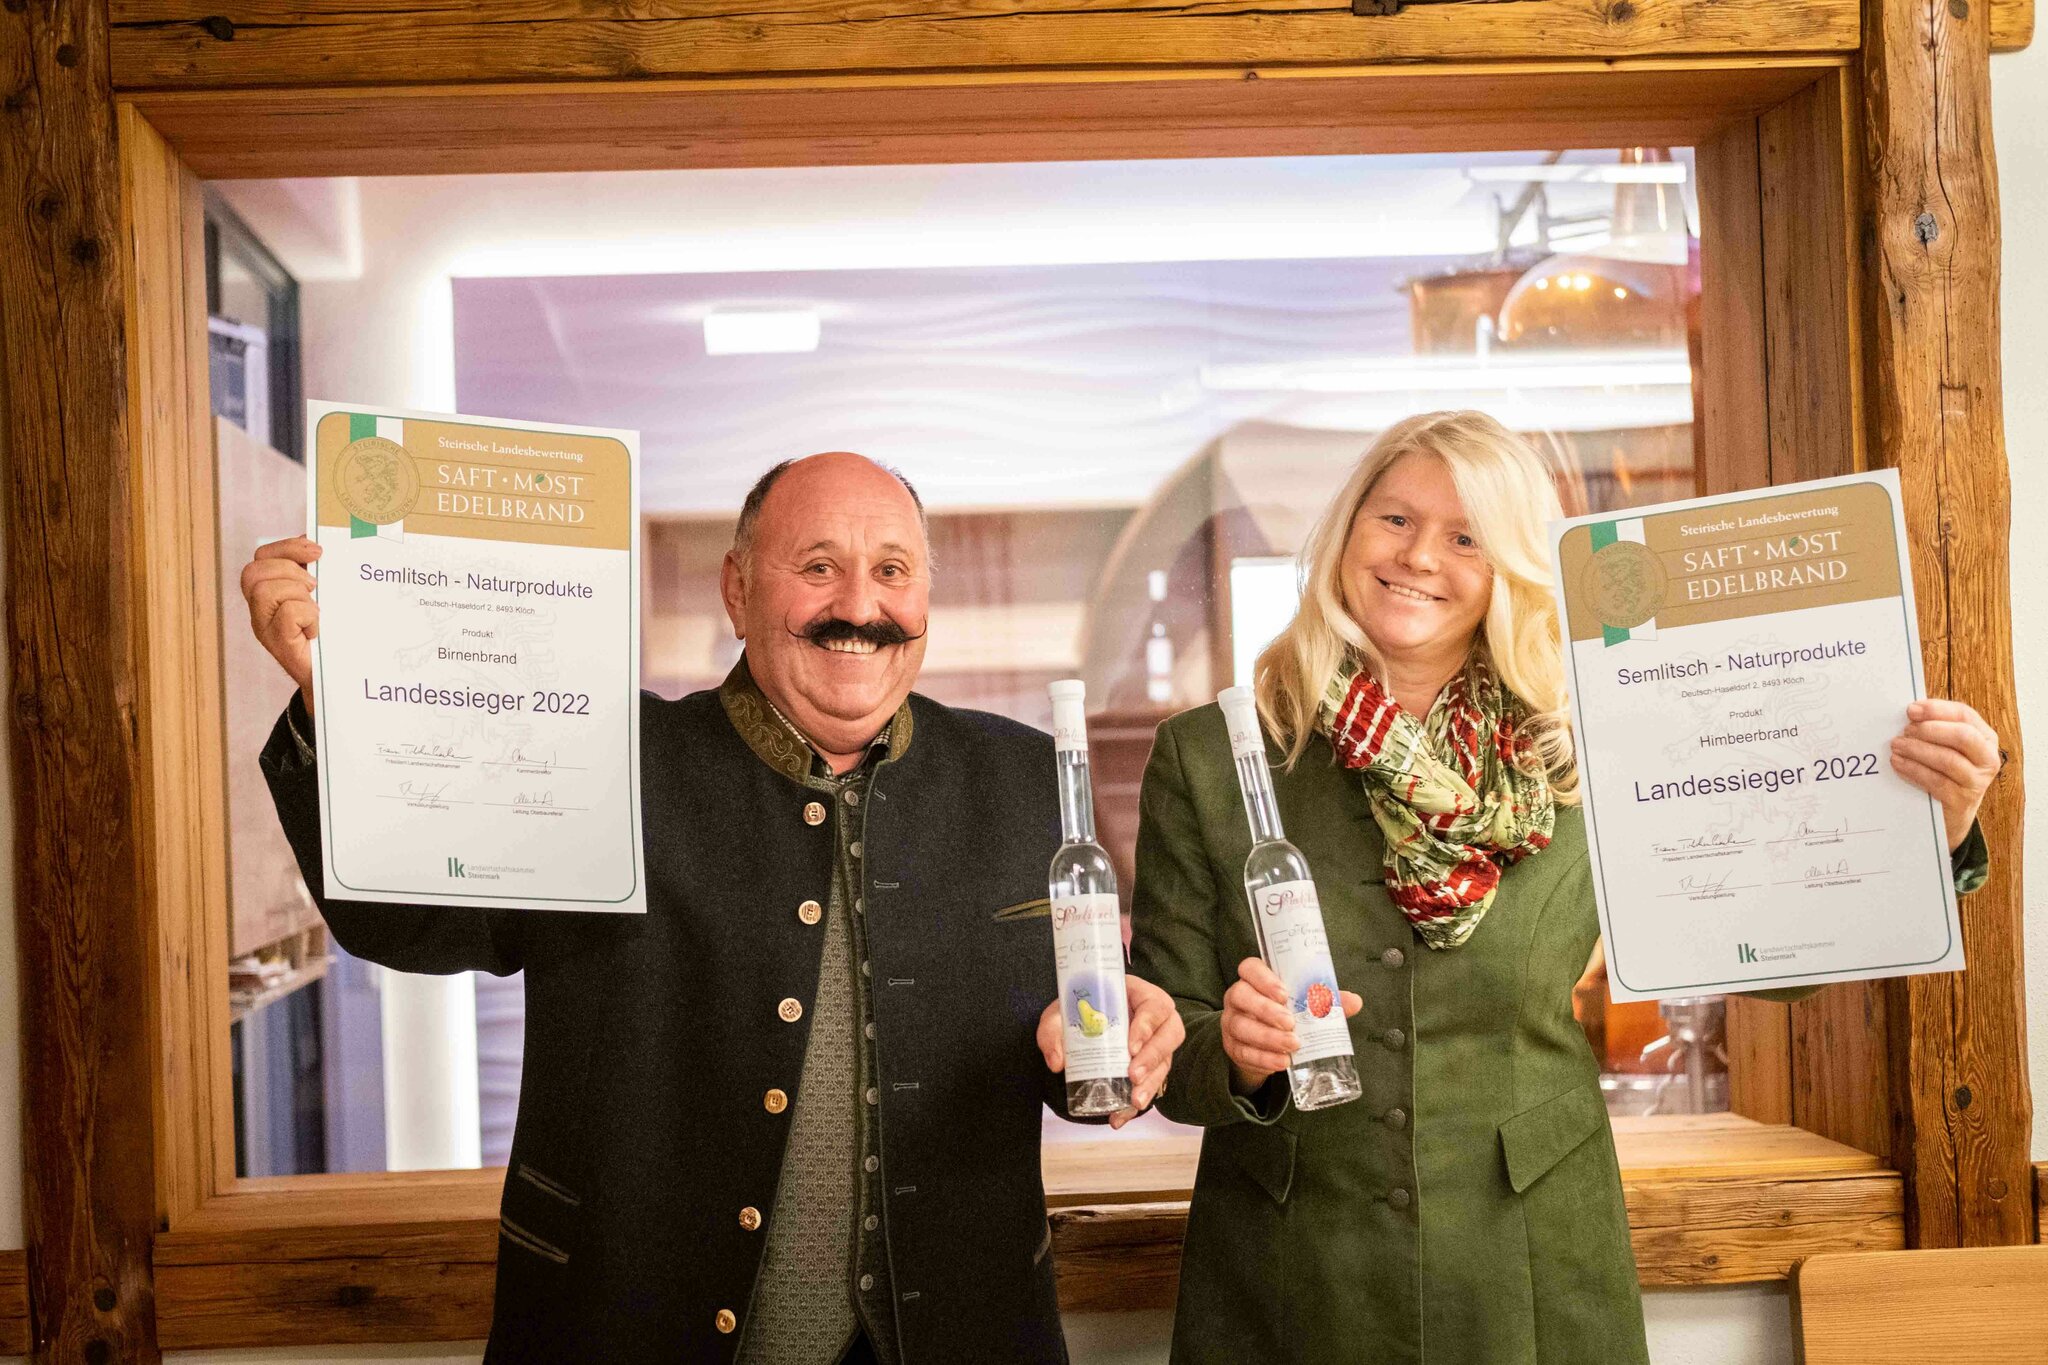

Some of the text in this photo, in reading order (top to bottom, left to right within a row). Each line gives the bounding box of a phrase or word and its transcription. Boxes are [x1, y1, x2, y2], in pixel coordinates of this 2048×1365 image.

[438, 437, 584, 462] Steirische Landesbewertung
[438, 464, 497, 486] SAFT
[438, 492, 585, 523] EDELBRAND
[1681, 504, 1839, 537] Steirische Landesbewertung
[1684, 545, 1747, 573] SAFT
[360, 563, 448, 588] Semlitsch
[467, 573, 593, 599] Naturprodukte
[1687, 560, 1848, 601] EDELBRAND
[496, 604, 514, 613] 8493
[462, 628, 494, 639] Produkt
[438, 647, 517, 665] Birnenbrand
[1618, 659, 1708, 685] Semlitsch
[1728, 639, 1866, 671] Naturprodukte
[364, 678, 590, 715] Landessieger 2022
[1762, 679, 1781, 688] 8493
[1729, 708, 1763, 719] Produkt
[1700, 724, 1798, 748] Himbeerbrand
[1635, 753, 1879, 802] Landessieger 2022
